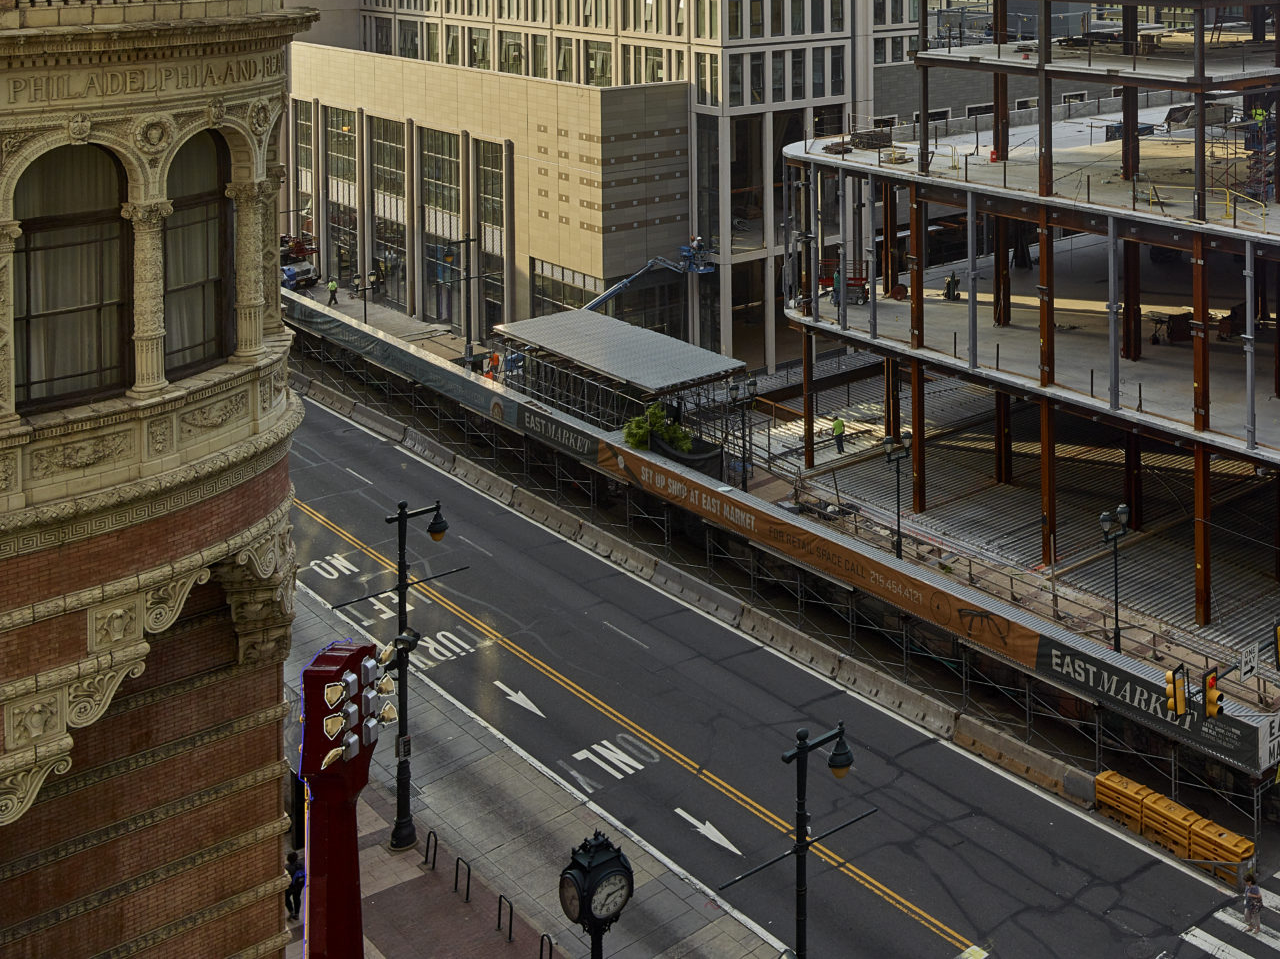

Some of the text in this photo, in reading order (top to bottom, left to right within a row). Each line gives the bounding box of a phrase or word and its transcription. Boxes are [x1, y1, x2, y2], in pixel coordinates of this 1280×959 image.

[8, 62, 218, 104] PHILADELPHIA
[222, 58, 257, 84] AND
[525, 412, 591, 454] EAST MARKET
[641, 466, 758, 533] SET UP SHOP AT EAST MARKET.
[310, 553, 360, 580] NO
[769, 526, 784, 541] FOR
[786, 534, 814, 555] RETAIL
[816, 546, 842, 568] SPACE
[844, 559, 866, 579] CALL
[1051, 649, 1097, 687] EAST
[1244, 646, 1256, 659] ONE
[1244, 655, 1256, 668] WAY
[556, 733, 660, 794] ONLY
